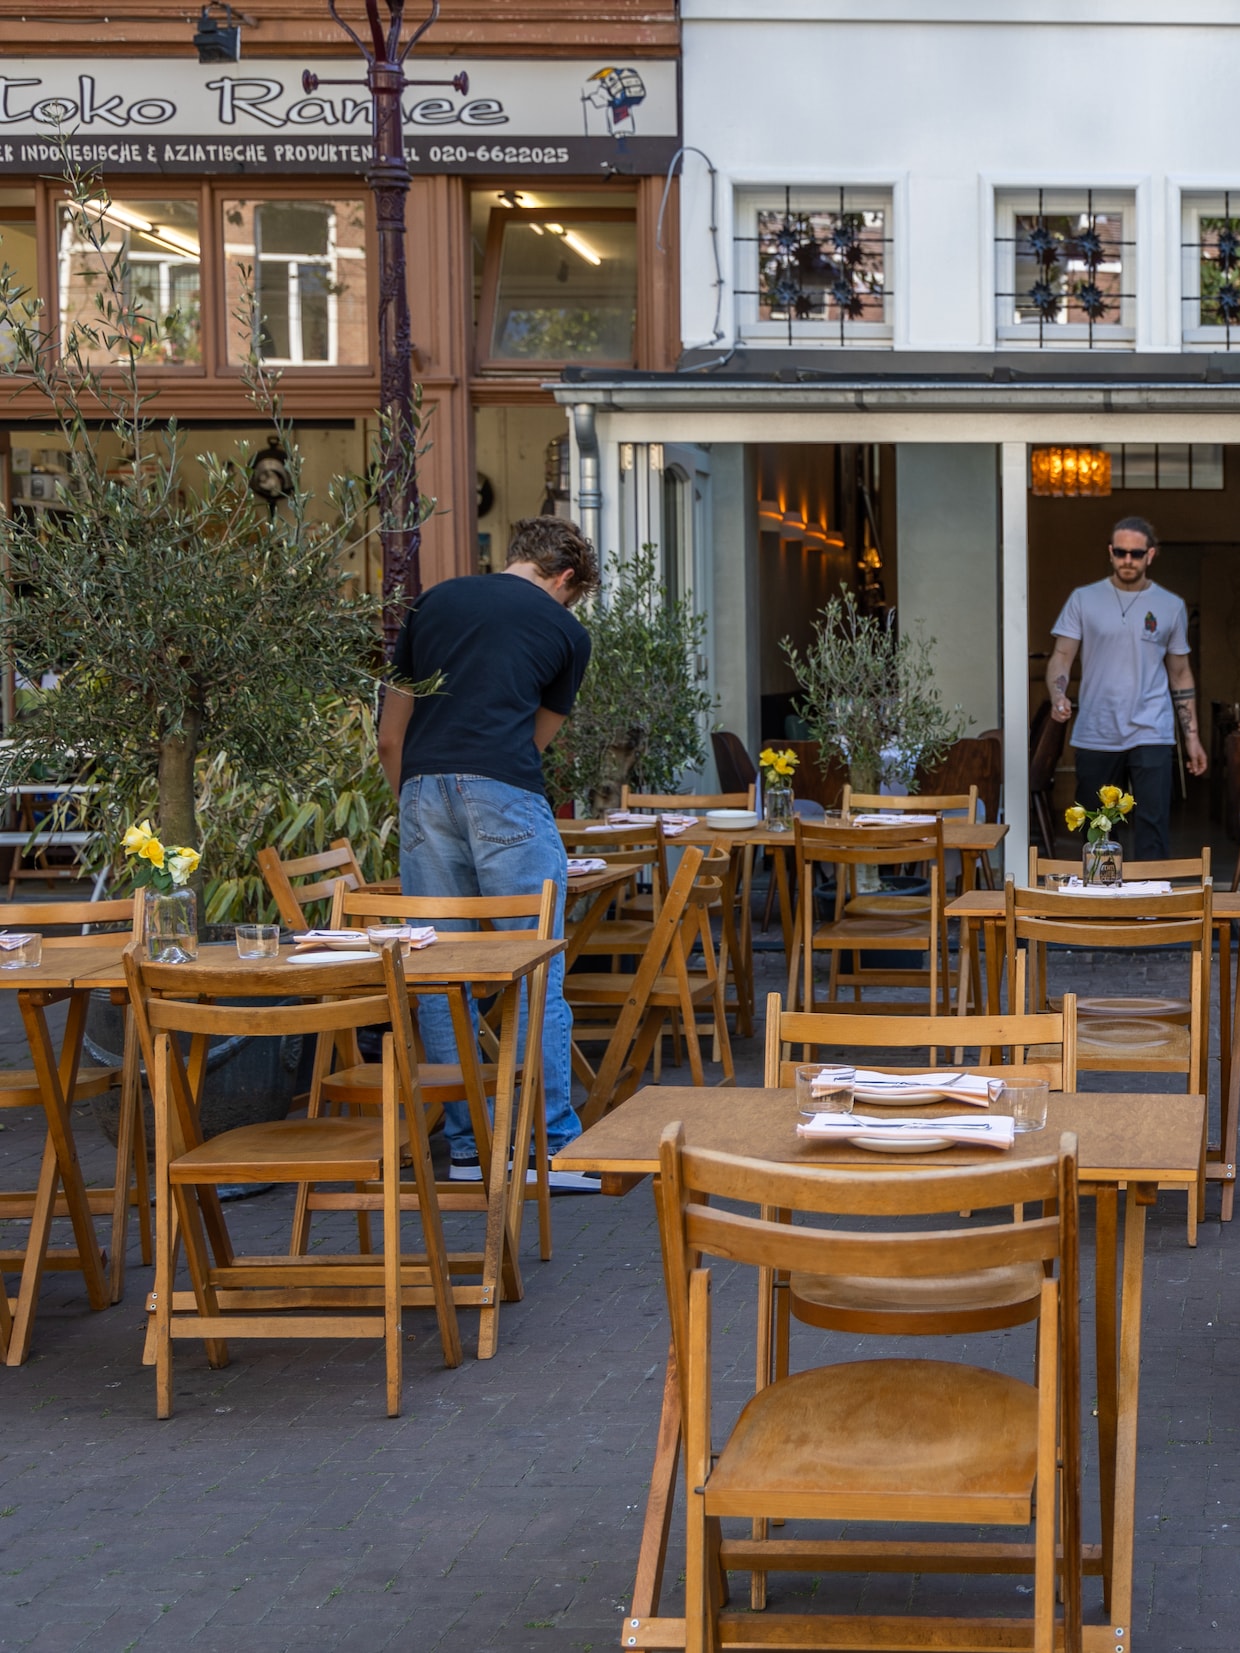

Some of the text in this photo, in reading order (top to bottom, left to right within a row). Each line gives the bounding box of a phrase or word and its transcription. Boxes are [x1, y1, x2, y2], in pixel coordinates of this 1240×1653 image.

[0, 74, 177, 127] Toko
[164, 144, 268, 162] AZIATISCHE
[274, 143, 373, 162] PRODUKTEN
[429, 146, 569, 164] 020-6622025
